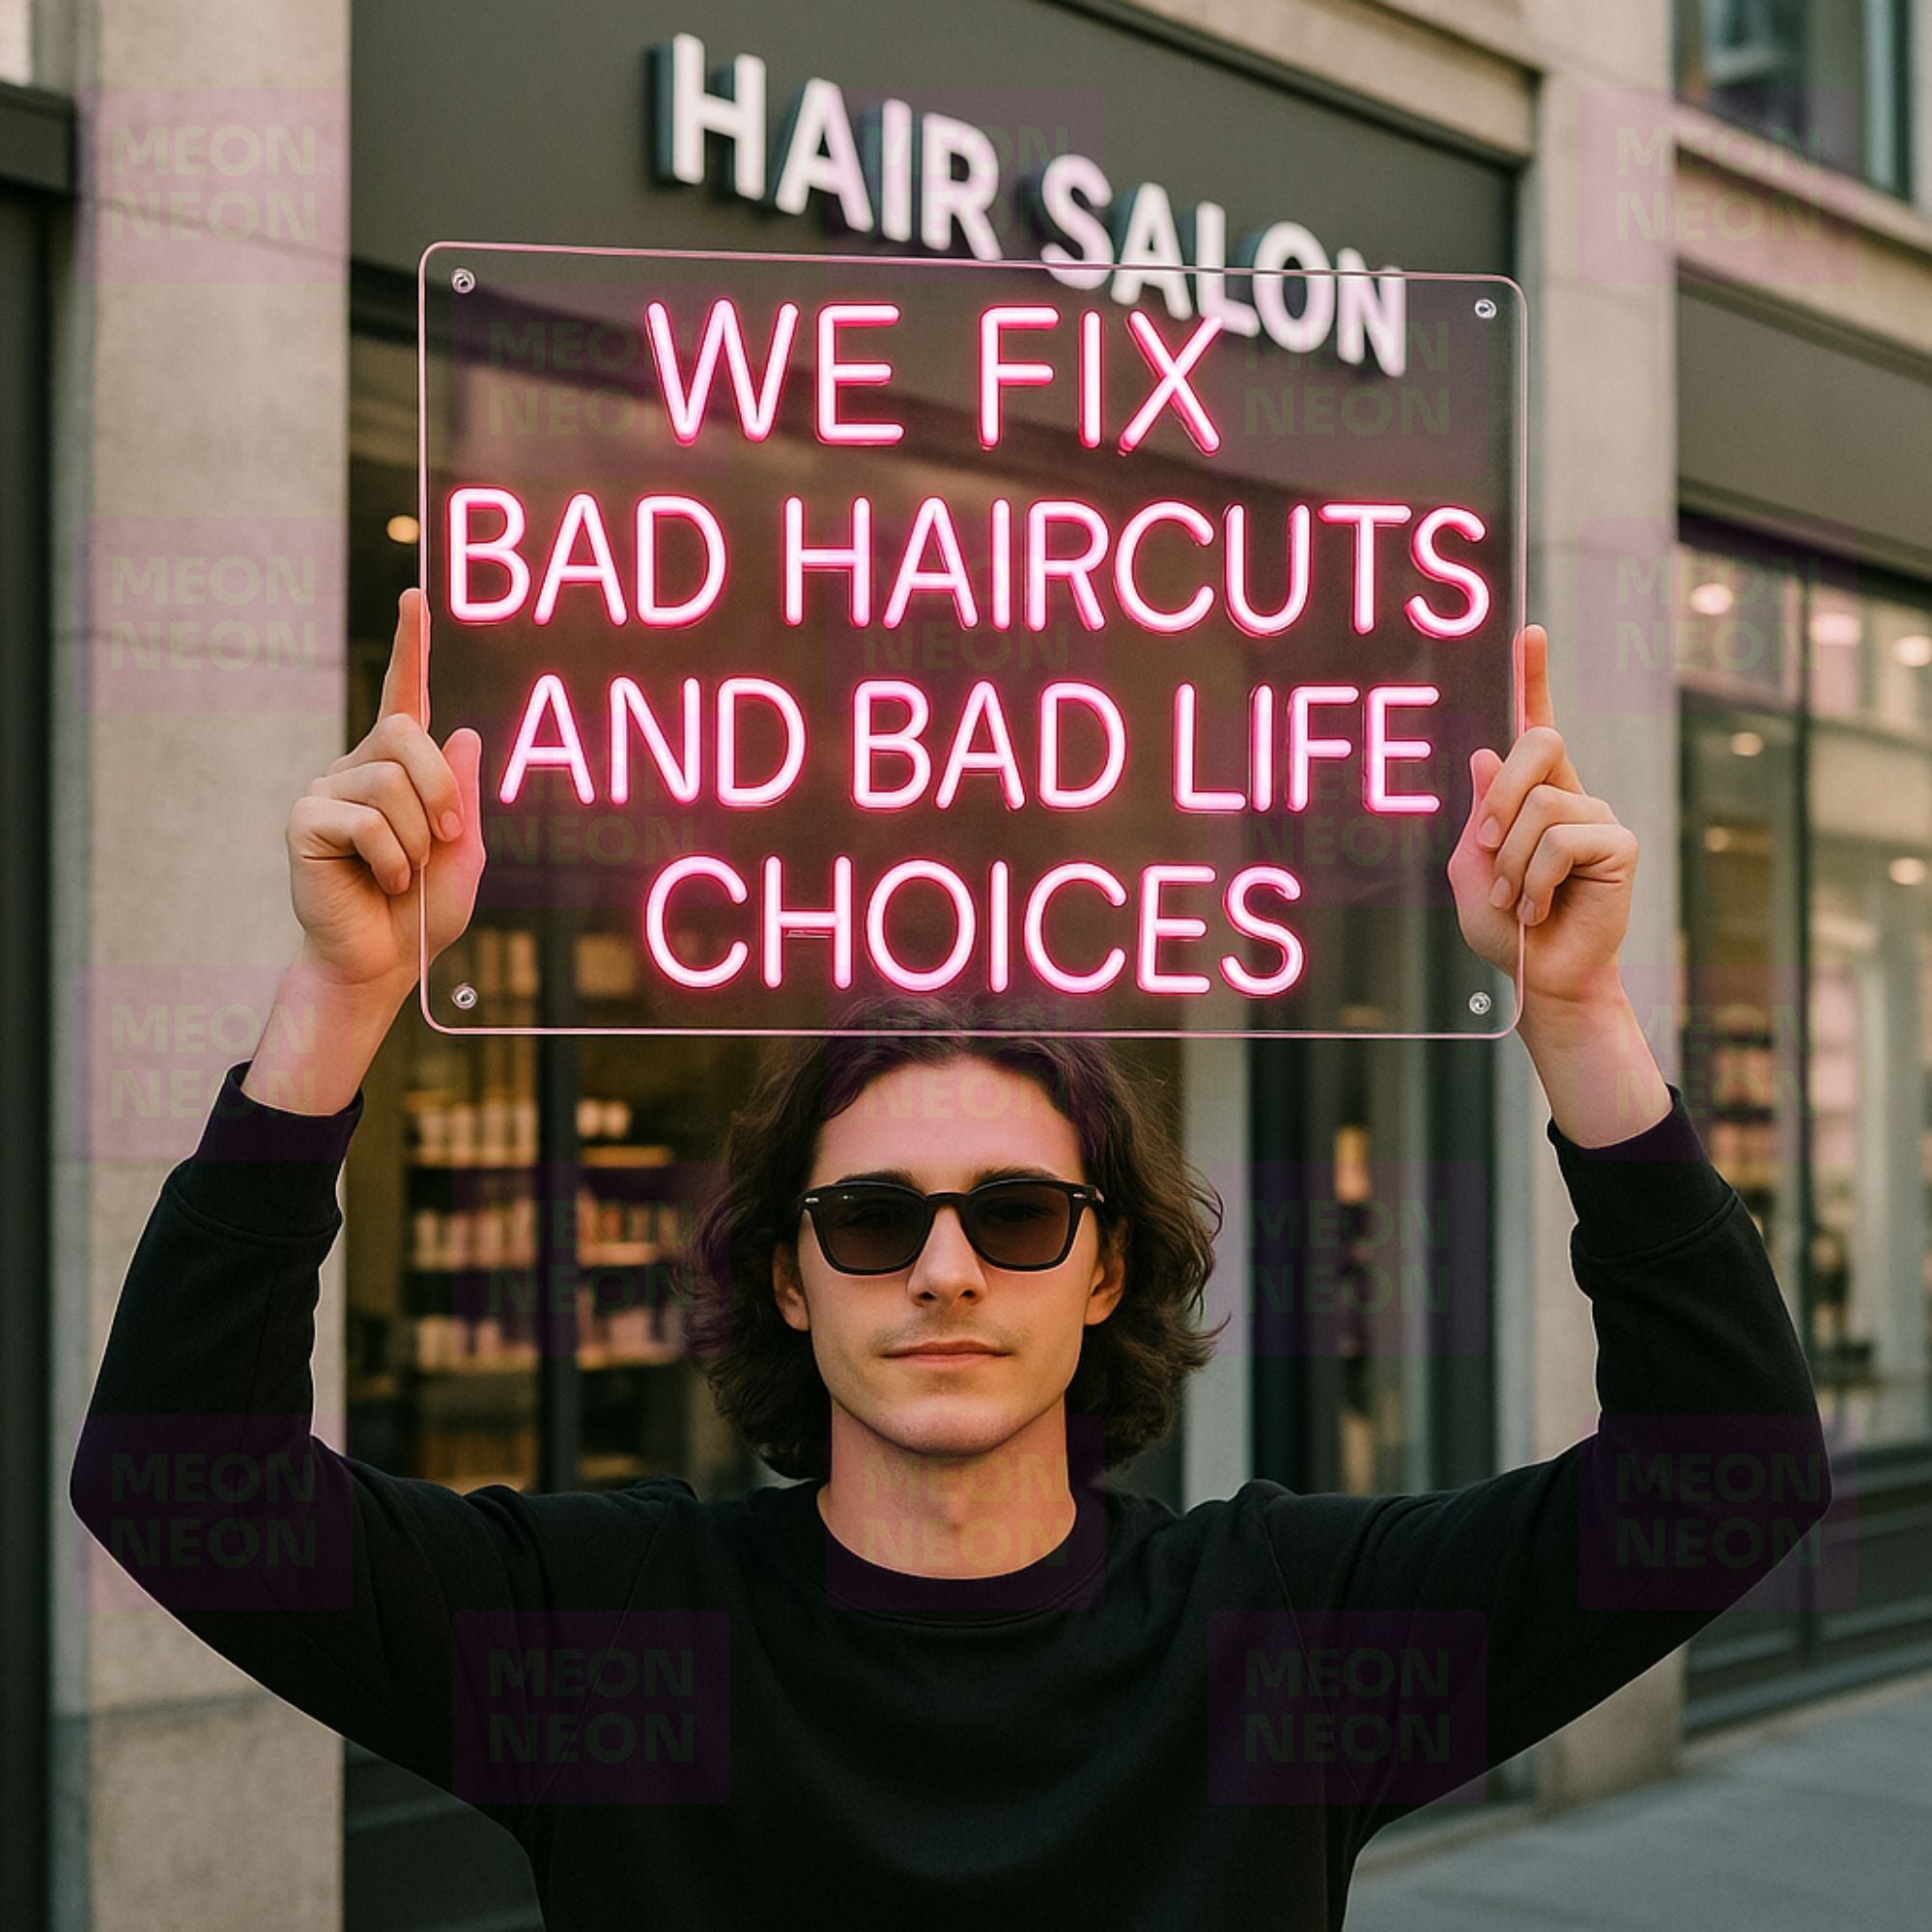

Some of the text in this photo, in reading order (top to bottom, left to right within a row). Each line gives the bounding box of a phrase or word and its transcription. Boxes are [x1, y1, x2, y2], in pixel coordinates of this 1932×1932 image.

[667, 33, 1406, 377] HAIR SALON
[645, 298, 1222, 457] WE FIX
[447, 486, 1491, 639] BAD HAIRCUTS
[497, 673, 1441, 813] AND BAD LIFE
[644, 854, 1304, 997] CHOICES
